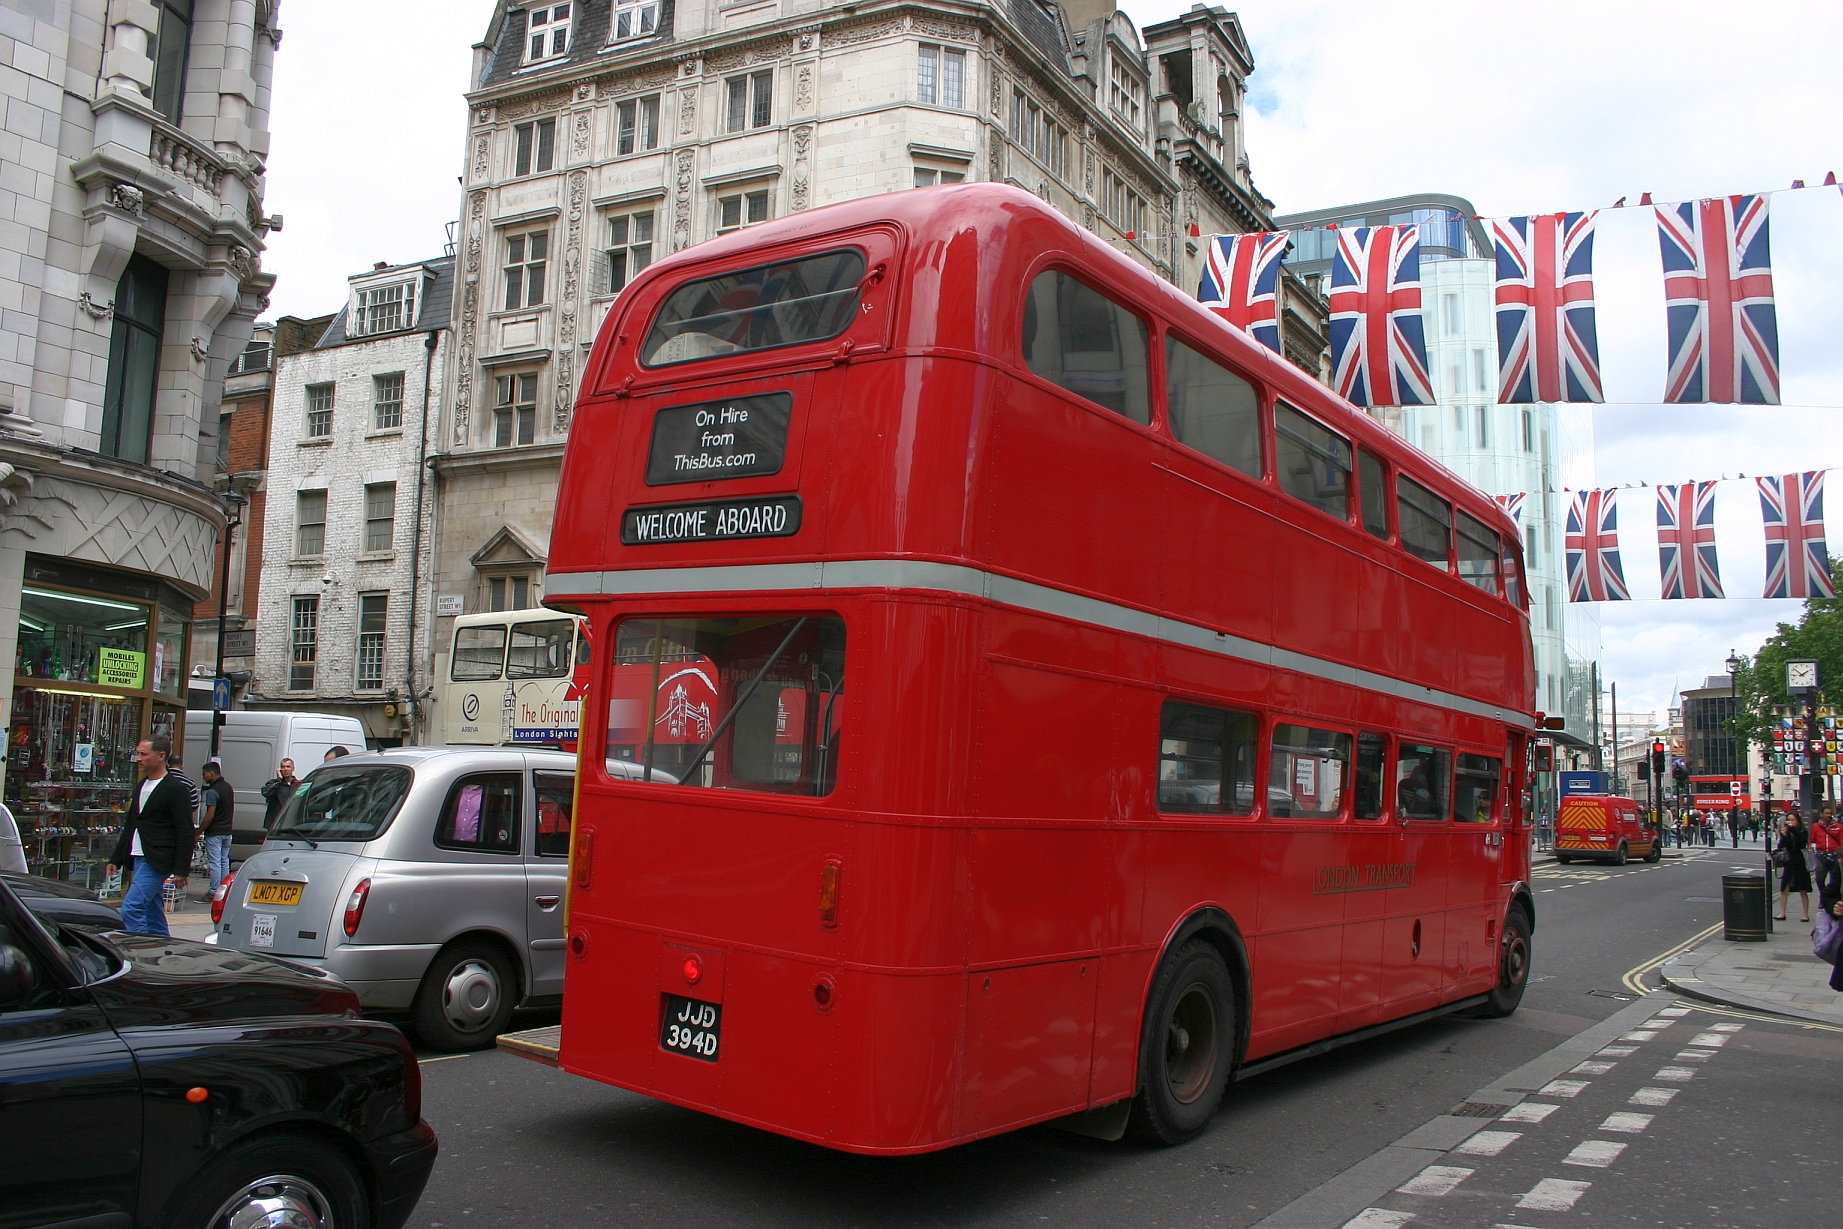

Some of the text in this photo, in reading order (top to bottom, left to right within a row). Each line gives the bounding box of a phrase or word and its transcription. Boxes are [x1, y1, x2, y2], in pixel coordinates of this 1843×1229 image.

[695, 407, 748, 427] On Hire
[701, 432, 734, 447] from
[674, 452, 756, 471] ThisBus.com
[636, 504, 787, 540] WELCOME ABOARD
[107, 651, 135, 661] MOBILES
[455, 653, 516, 672] COVENTY
[102, 658, 139, 672] UNLOCKING
[102, 669, 138, 679] ACCESSORIES
[107, 676, 132, 685] REPAIRS
[521, 701, 579, 728] The Original
[515, 730, 578, 739] London Sights
[1313, 862, 1417, 894] LONDON TRANSPORT
[253, 885, 298, 901] LM07 XGP
[254, 926, 273, 937] 91646
[677, 1001, 716, 1028] JJD
[666, 1024, 717, 1056] 394D
